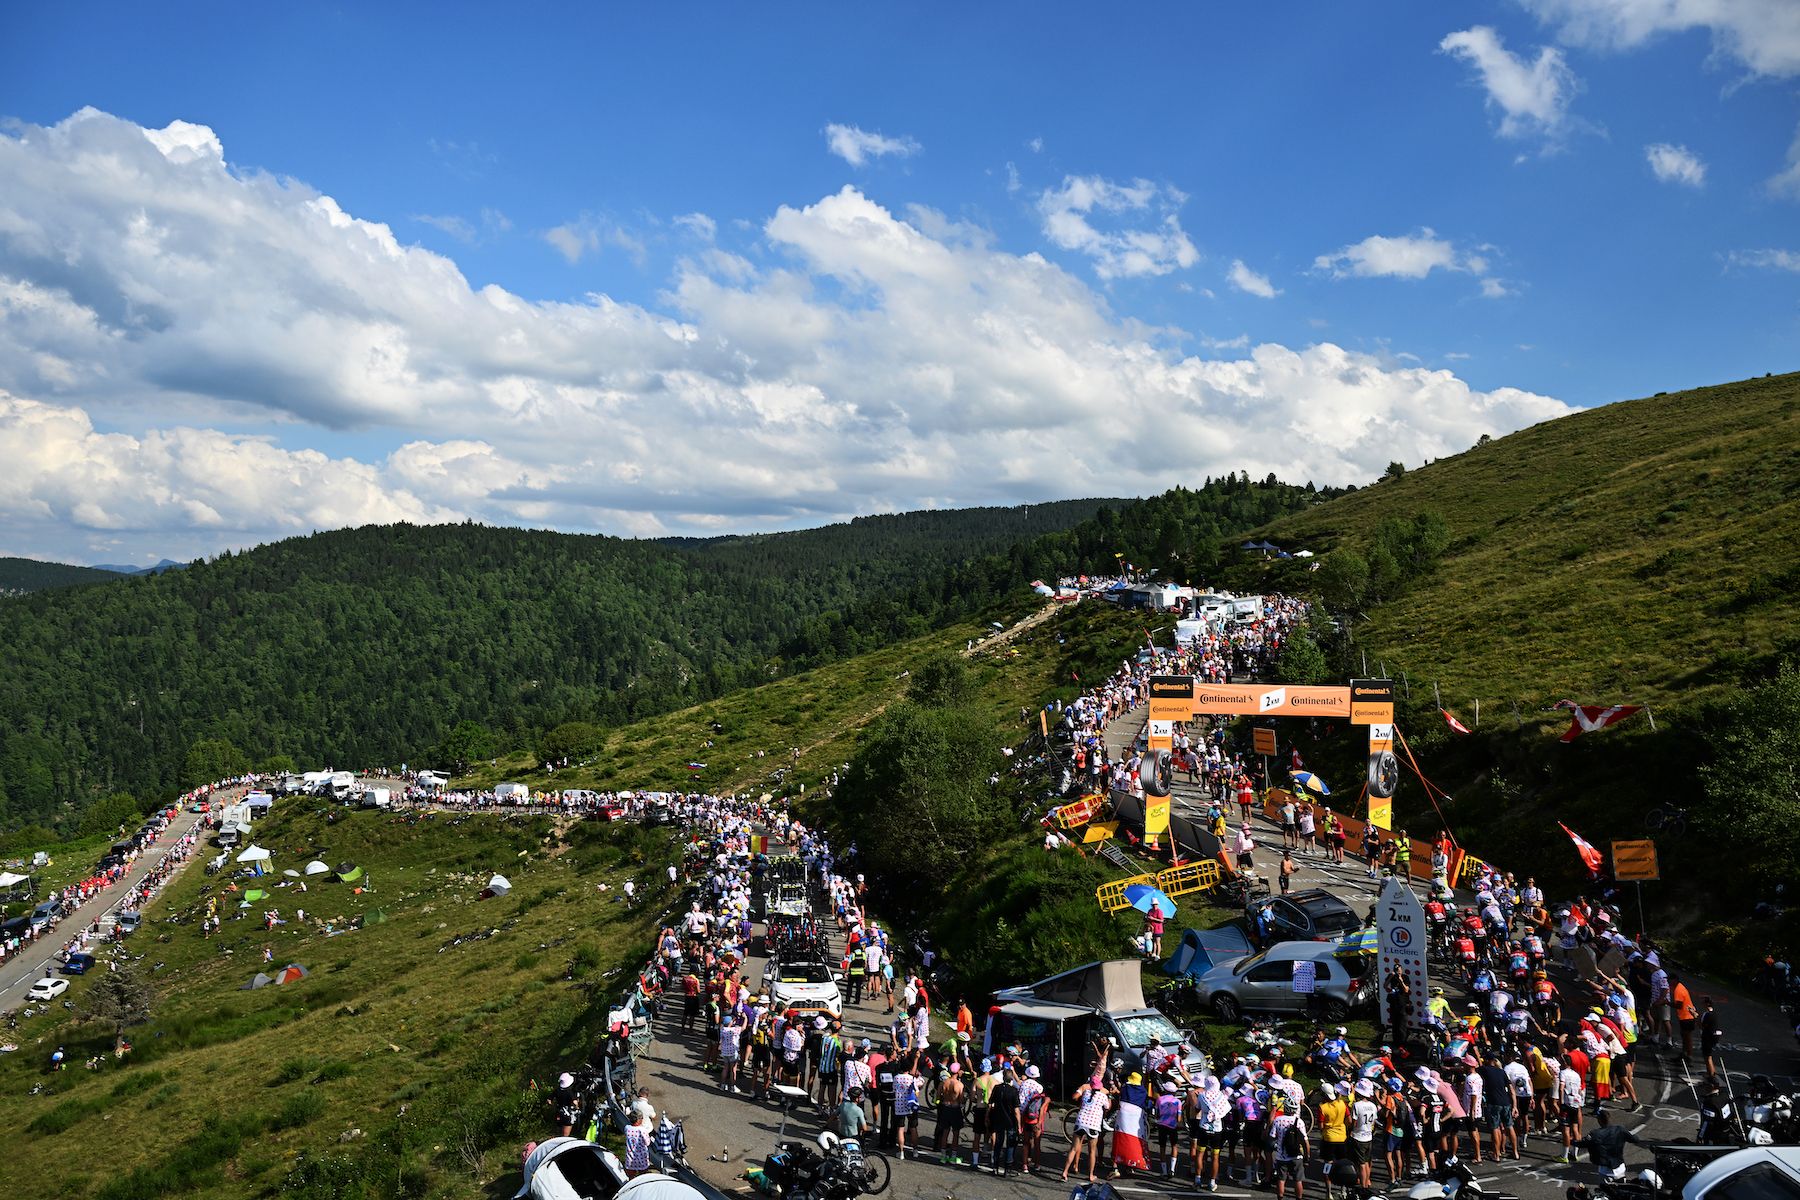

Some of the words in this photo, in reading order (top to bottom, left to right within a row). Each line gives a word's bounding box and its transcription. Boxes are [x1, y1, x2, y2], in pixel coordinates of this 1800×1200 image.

[1153, 683, 1185, 691] Continental
[1200, 694, 1246, 704] Continental
[1291, 696, 1336, 706] Continental
